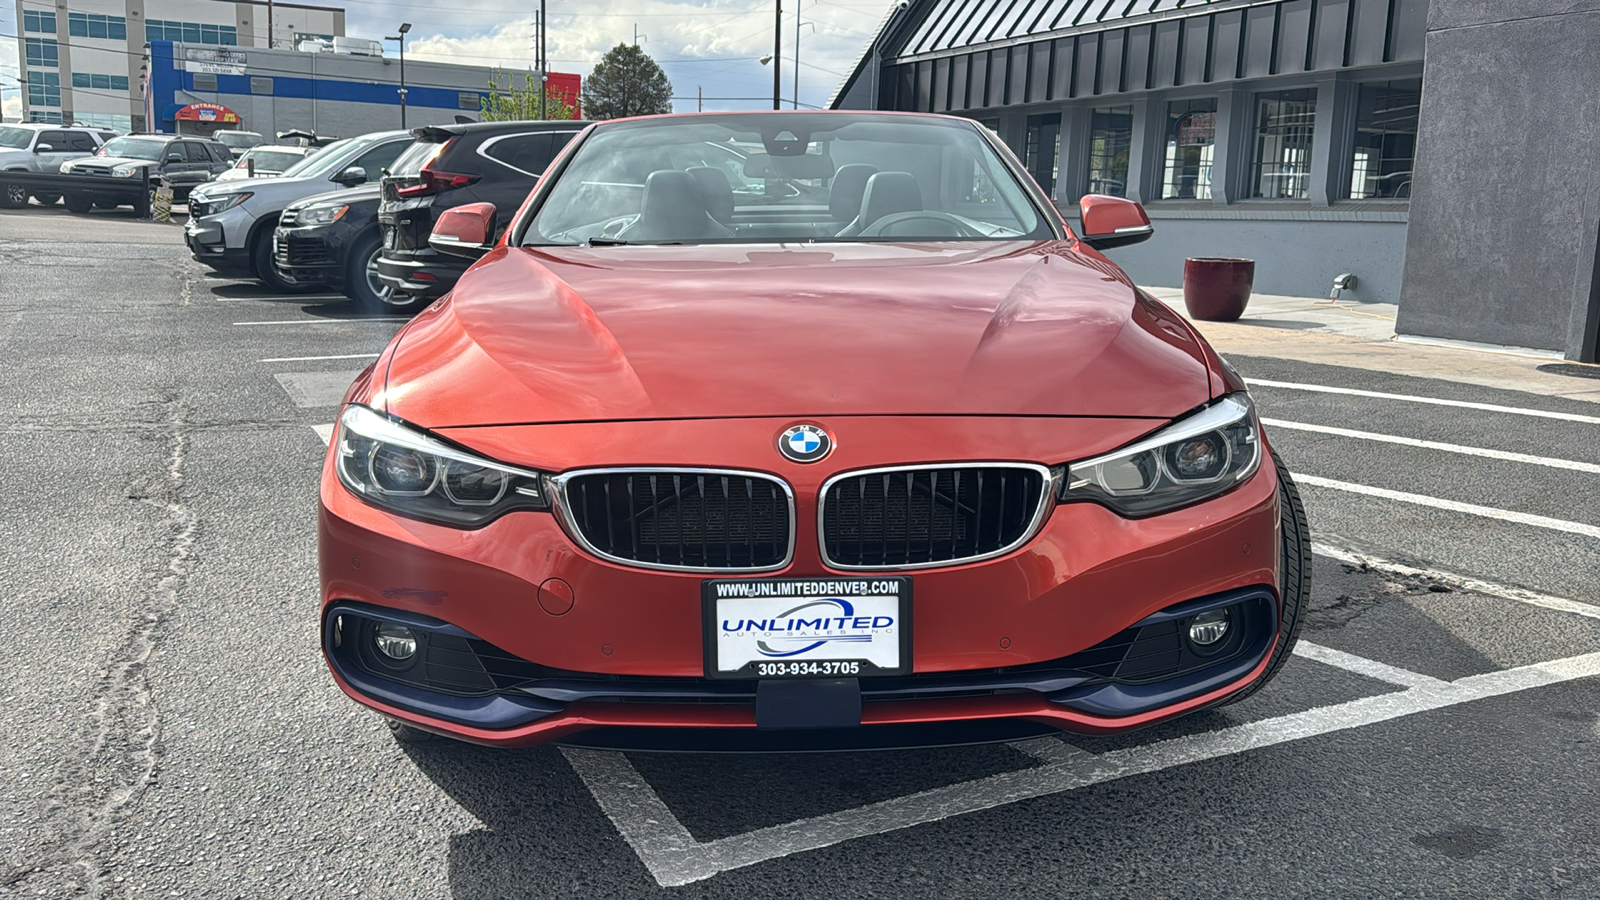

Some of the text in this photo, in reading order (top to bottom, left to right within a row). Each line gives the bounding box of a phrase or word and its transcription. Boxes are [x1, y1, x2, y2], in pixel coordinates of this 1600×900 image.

[190, 103, 224, 111] ENTRANCE
[716, 581, 899, 597] WWWUNLIMITEDDENVER.COM
[722, 616, 894, 632] UNLIMITED
[758, 661, 860, 676] 303-934-3705
